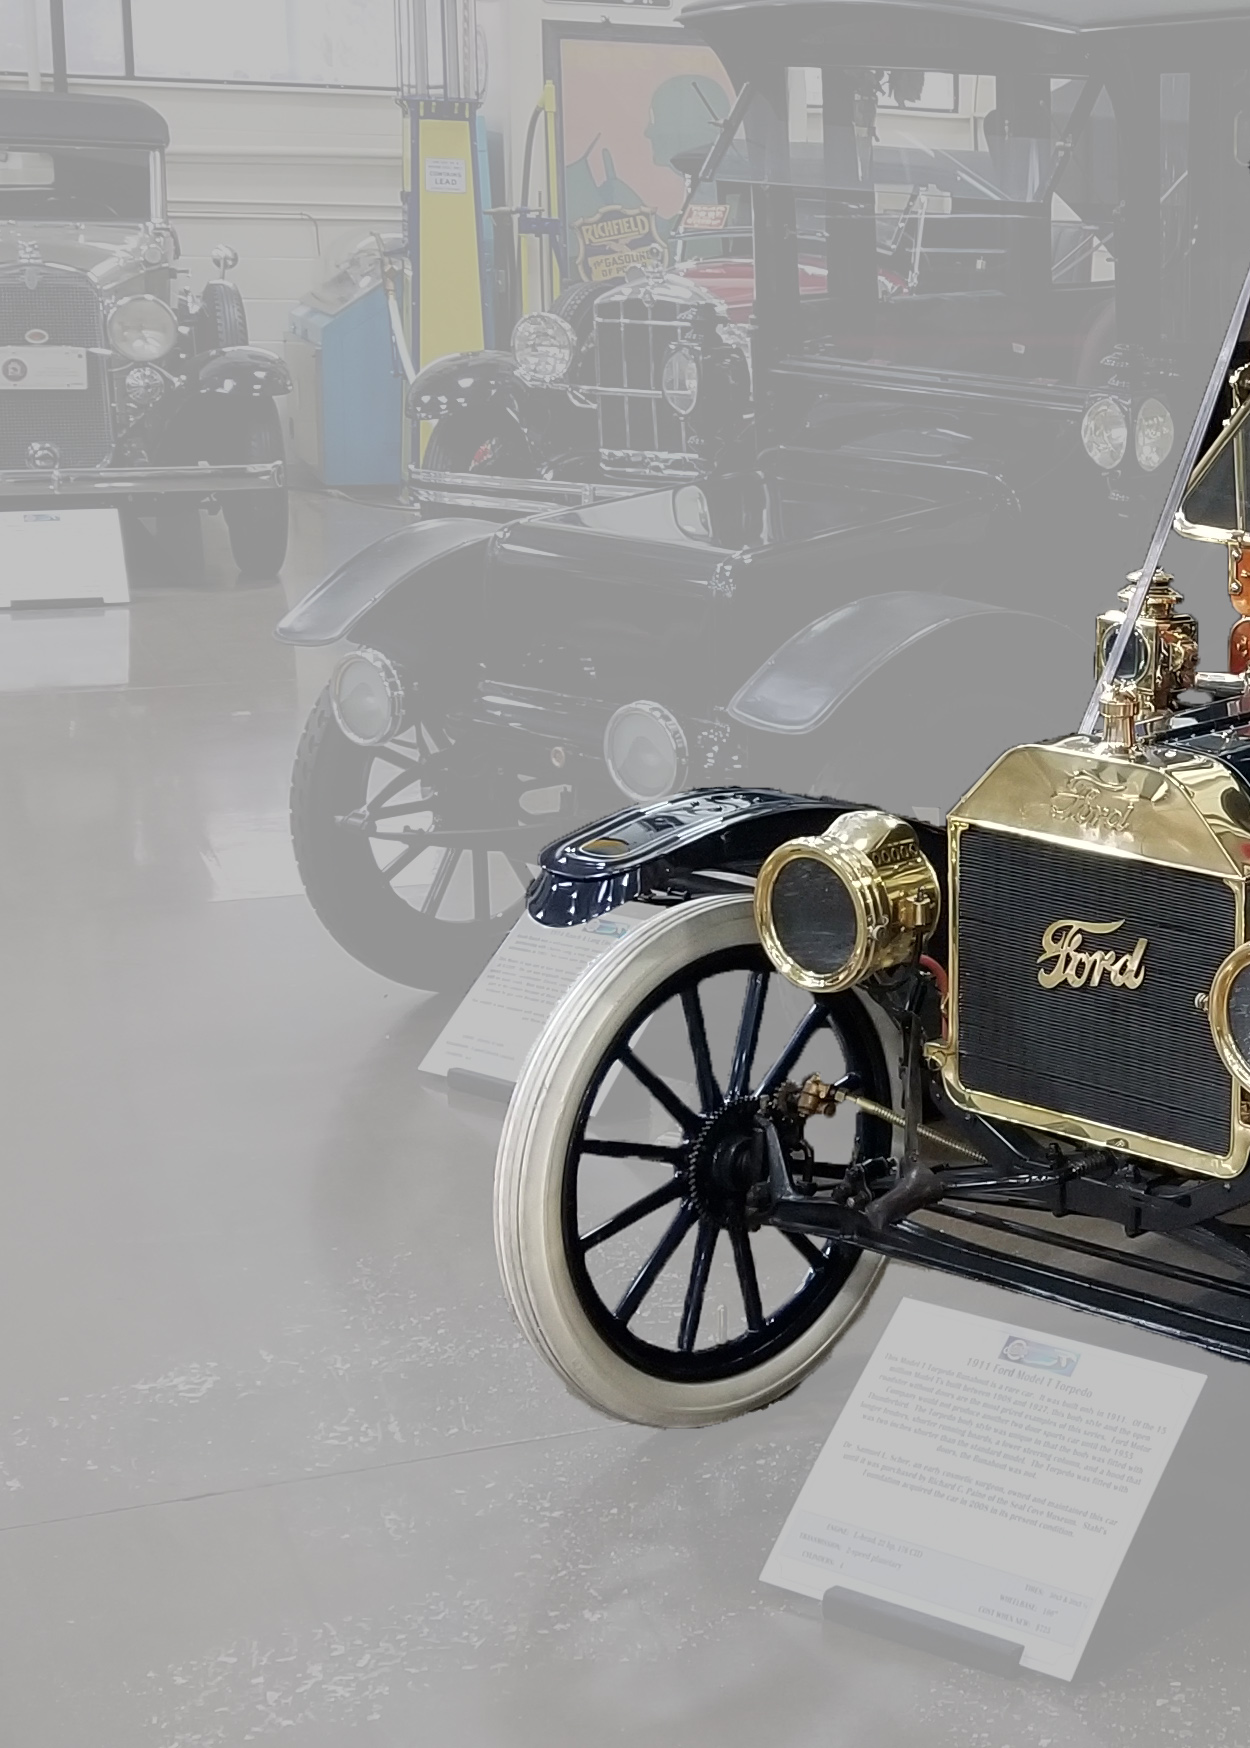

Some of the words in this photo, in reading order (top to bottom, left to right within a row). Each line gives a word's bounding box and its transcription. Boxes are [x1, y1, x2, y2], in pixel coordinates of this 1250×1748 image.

[435, 178, 457, 186] LEAD
[582, 215, 650, 245] RICHFIELD
[601, 267, 613, 278] OF
[1050, 768, 1136, 834] Ford
[1037, 919, 1148, 990] Ford
[967, 1358, 990, 1370] 1911
[993, 1364, 1015, 1377] Ford
[1017, 1370, 1044, 1384] Model
[1055, 1380, 1092, 1397] Torpedo
